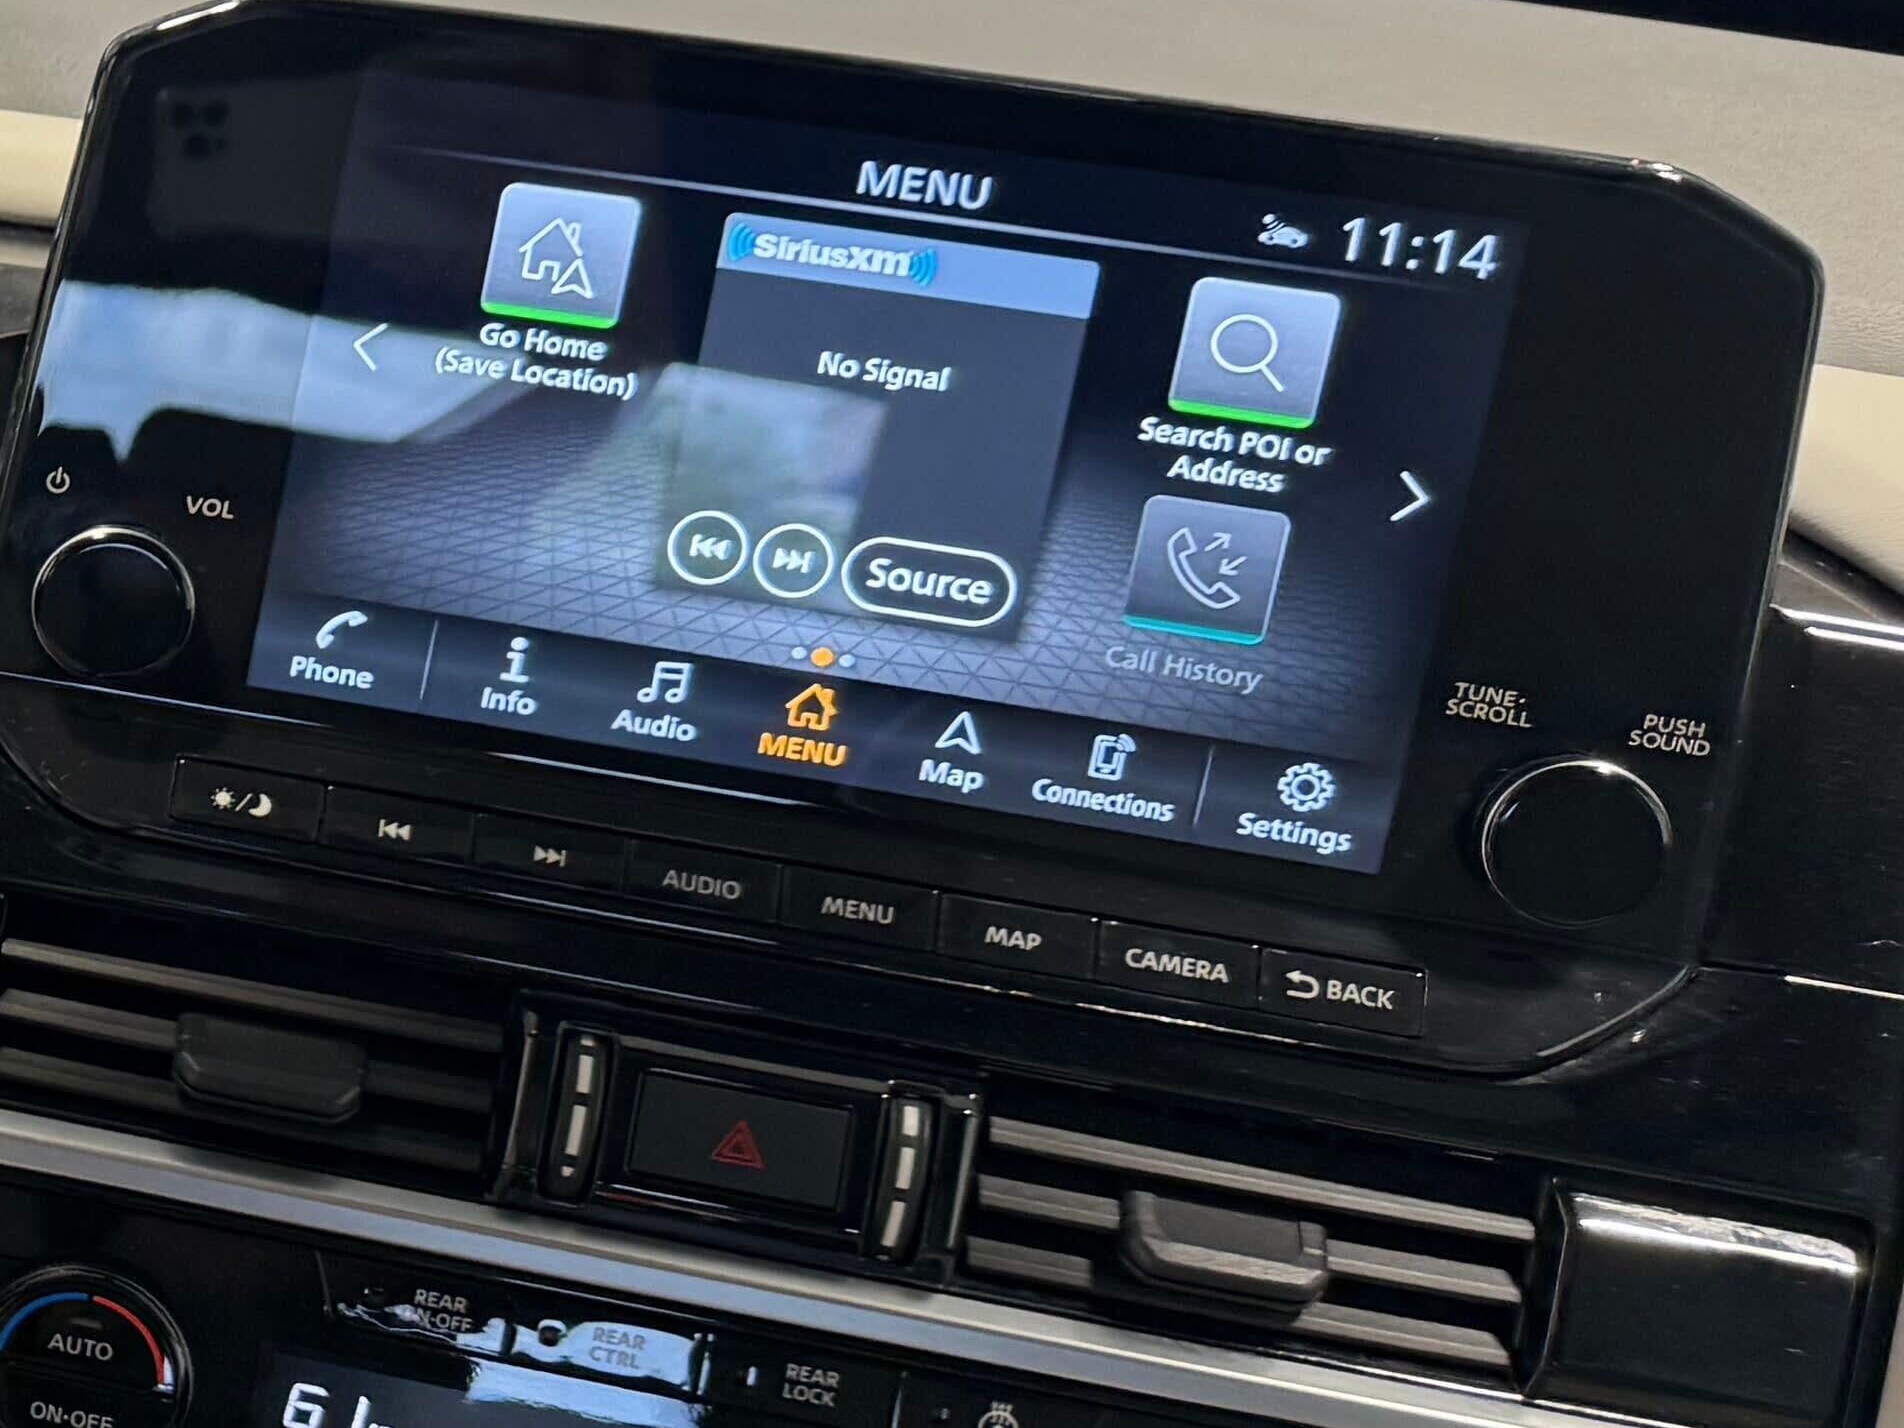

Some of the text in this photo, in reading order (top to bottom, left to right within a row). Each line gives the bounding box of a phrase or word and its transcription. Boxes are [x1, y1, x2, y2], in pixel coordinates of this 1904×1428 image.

[856, 160, 993, 210] MENU
[1340, 215, 1501, 282] 11:14
[480, 323, 607, 362] Go Home
[435, 347, 637, 401] (Save Location)
[817, 351, 952, 392] No Signal
[1137, 417, 1333, 466] Search POI or
[1166, 455, 1286, 493] Address
[185, 494, 234, 521] VOL
[866, 556, 992, 606] Source
[290, 654, 374, 690] Phone
[1105, 645, 1264, 695] Call History
[480, 687, 536, 716] Info
[1445, 698, 1531, 728] SCROLL
[612, 707, 696, 743] Audio
[1628, 729, 1711, 756] SOUND
[1643, 714, 1706, 737] PUSH
[758, 731, 847, 767] MENU
[919, 758, 984, 794] Map
[1031, 778, 1174, 824] Connections
[1236, 811, 1352, 855] Settings
[662, 869, 742, 900] AUDIO
[821, 894, 894, 925] MENU
[984, 925, 1042, 953] MAP
[1124, 946, 1228, 985] CAMERA
[1325, 979, 1395, 1010] BACK
[414, 1289, 468, 1313] REAR
[47, 1332, 113, 1362] AUTO
[592, 1326, 646, 1351] REAR
[589, 1346, 641, 1370] CTRL
[784, 1363, 840, 1389] REAR
[782, 1381, 836, 1407] LOCK
